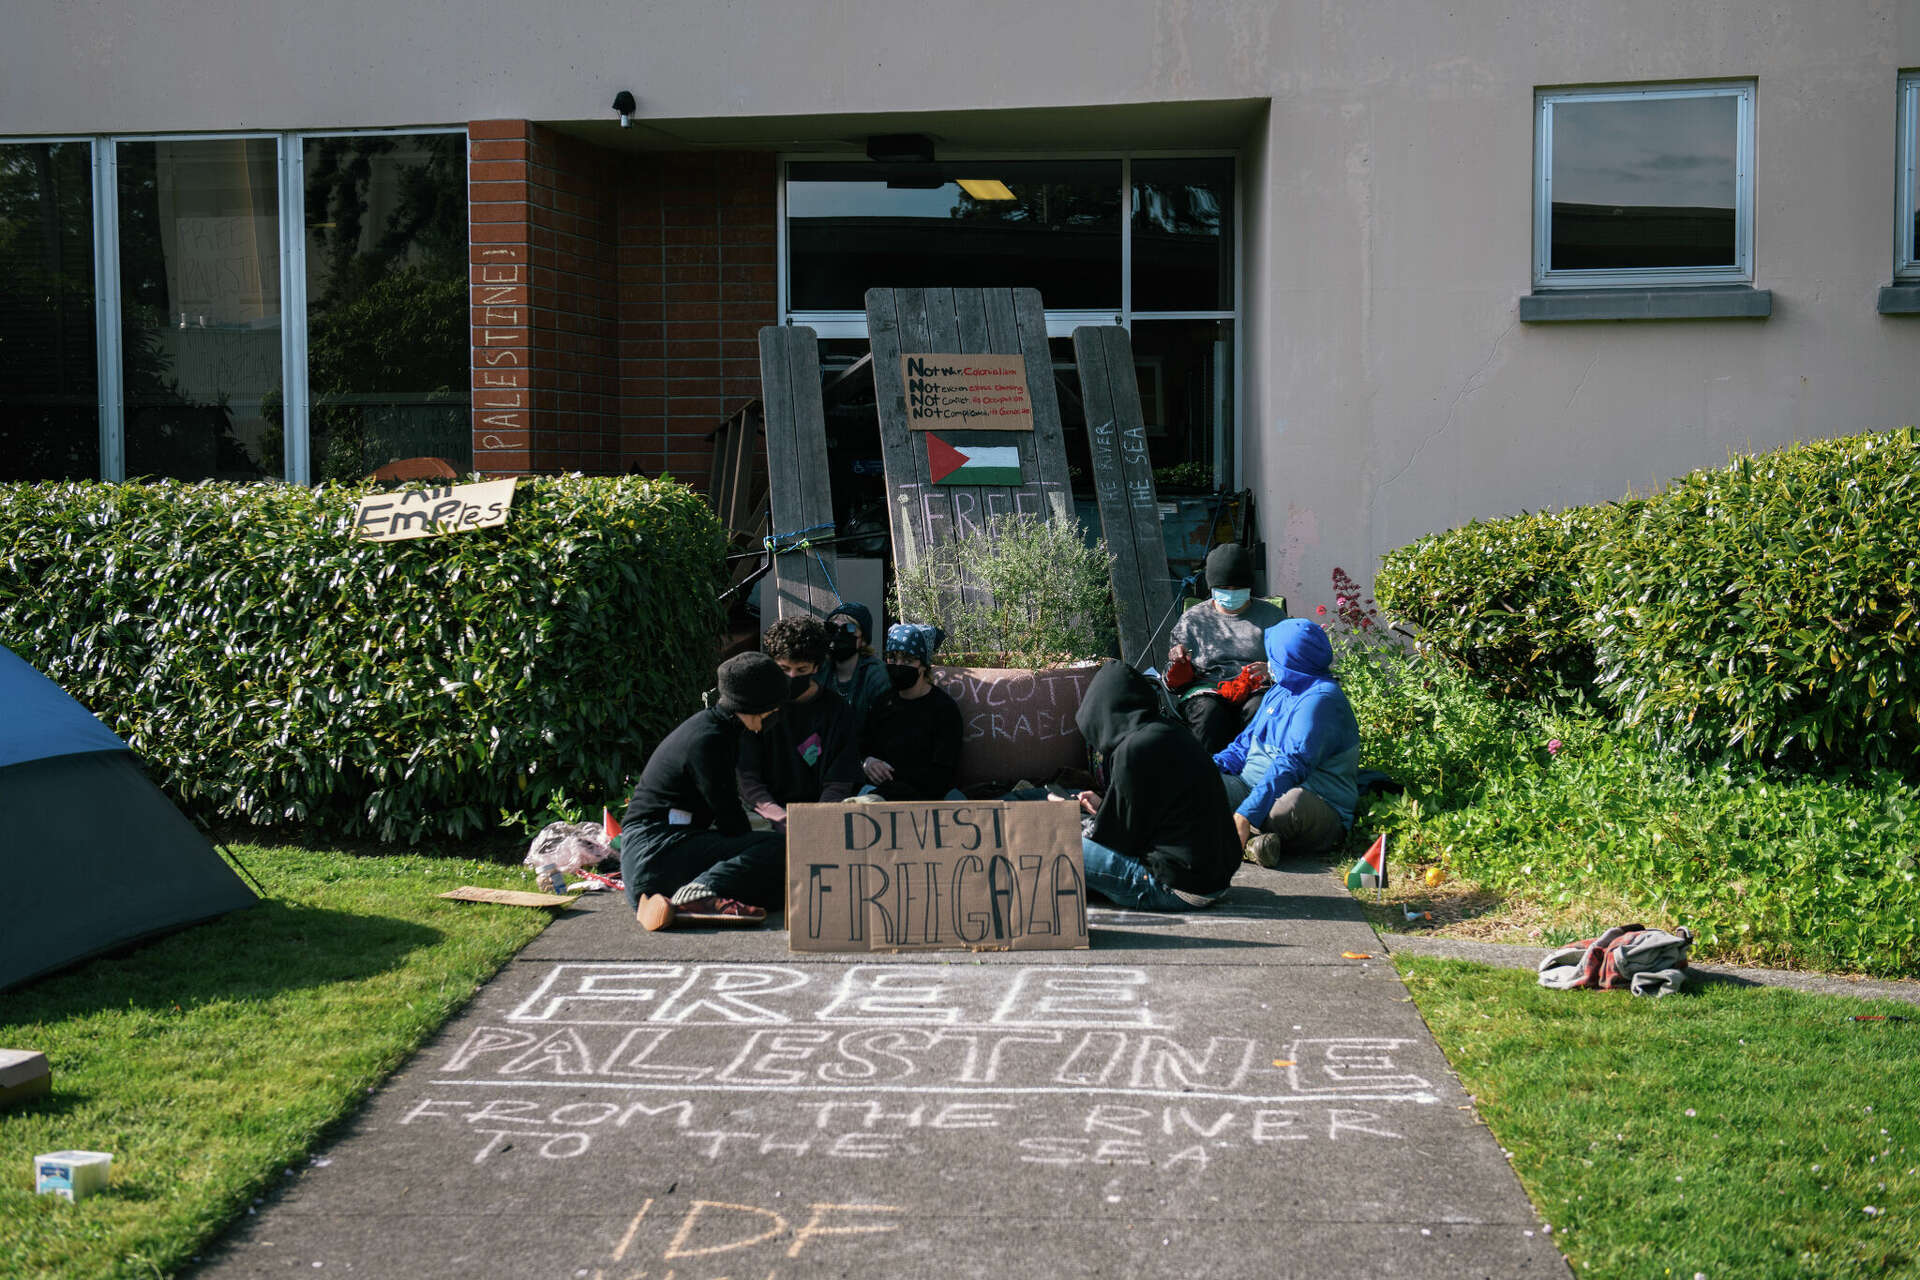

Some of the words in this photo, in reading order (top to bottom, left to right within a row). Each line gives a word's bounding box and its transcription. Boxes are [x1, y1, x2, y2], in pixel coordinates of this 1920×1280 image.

[1122, 425, 1148, 465] SEA
[844, 807, 1011, 851] DIVEST
[506, 963, 1155, 1027] FREE
[440, 1025, 1432, 1093] PALESTINE
[401, 1098, 695, 1128] FROM
[799, 1101, 1016, 1130] THE
[1085, 1104, 1404, 1141] RIVER
[474, 1129, 592, 1164] TO
[681, 1131, 904, 1159] THE
[1018, 1137, 1211, 1170] SEA
[612, 1198, 904, 1262] IDF
